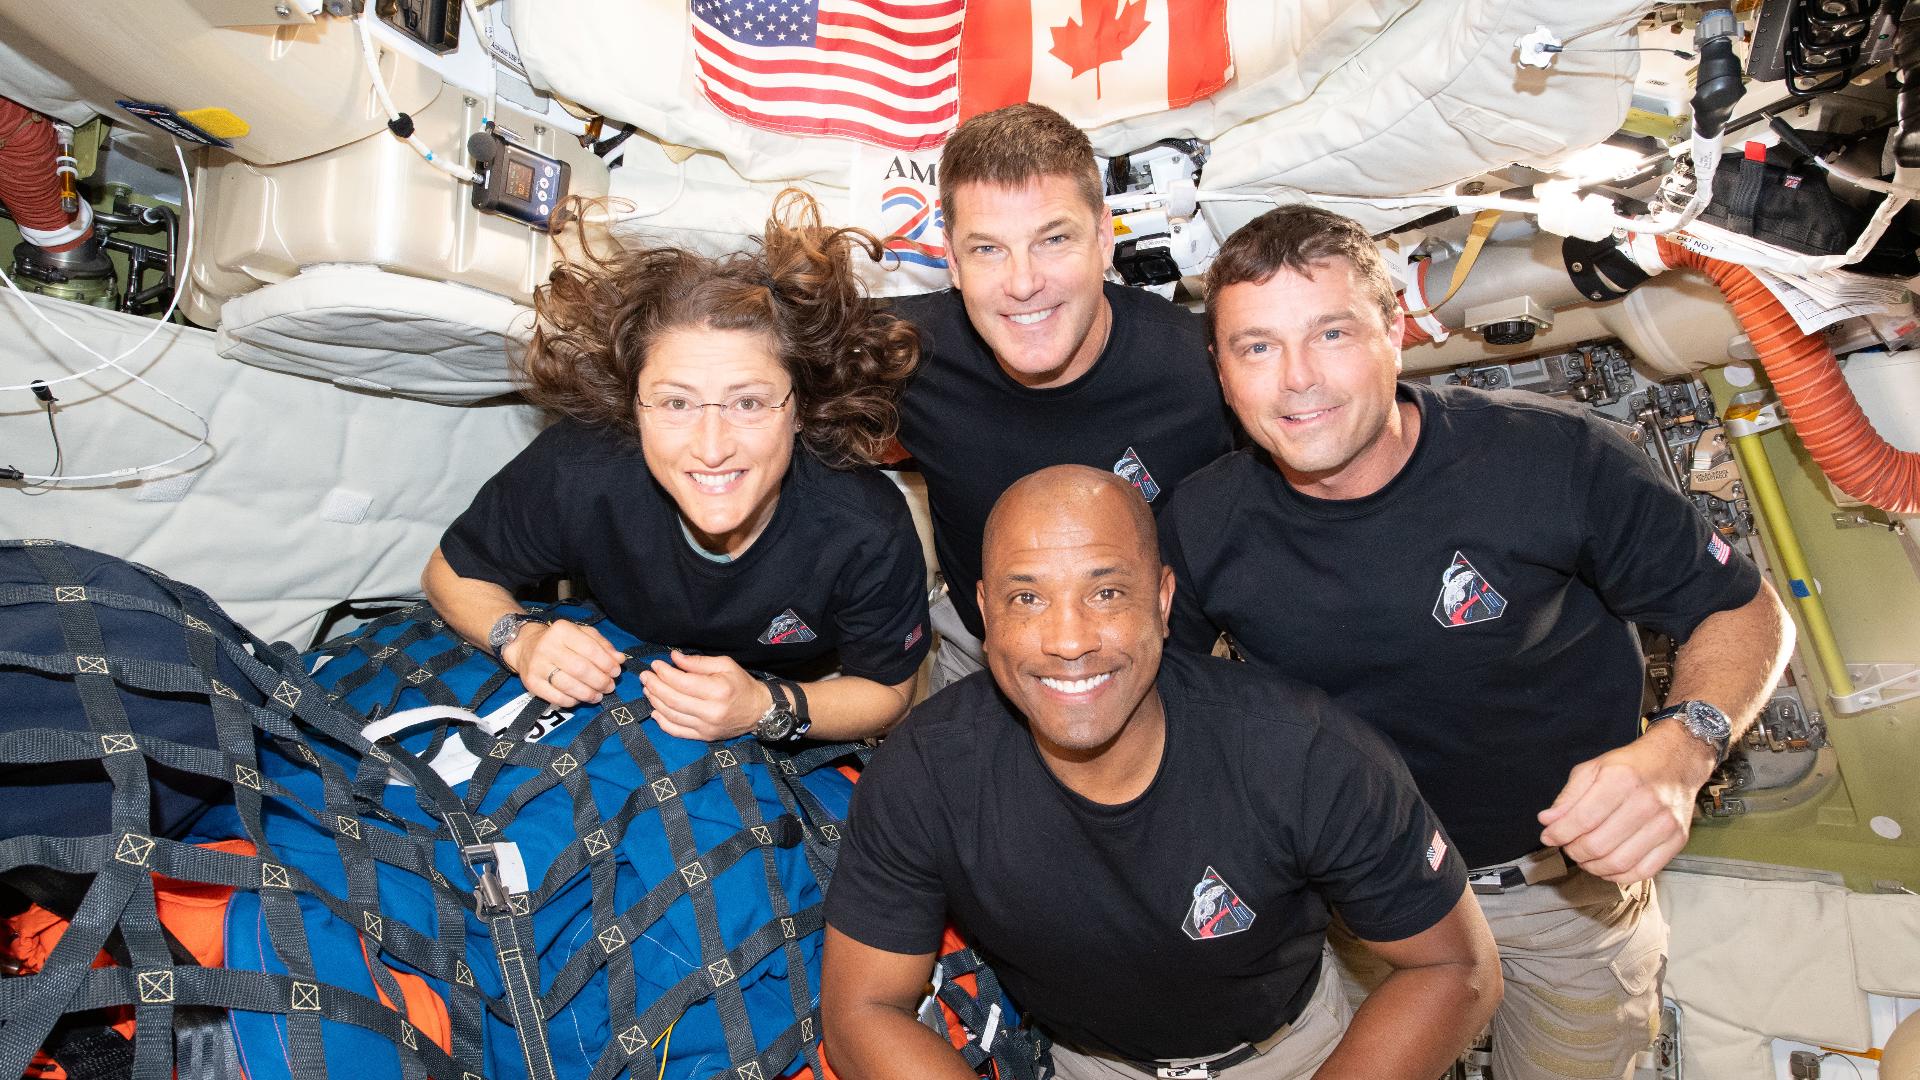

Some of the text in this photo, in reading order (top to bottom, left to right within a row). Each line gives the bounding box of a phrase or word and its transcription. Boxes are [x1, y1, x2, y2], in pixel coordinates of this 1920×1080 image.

[883, 155, 937, 186] AM
[1676, 235, 1692, 243] DO
[1693, 240, 1714, 253] NOT
